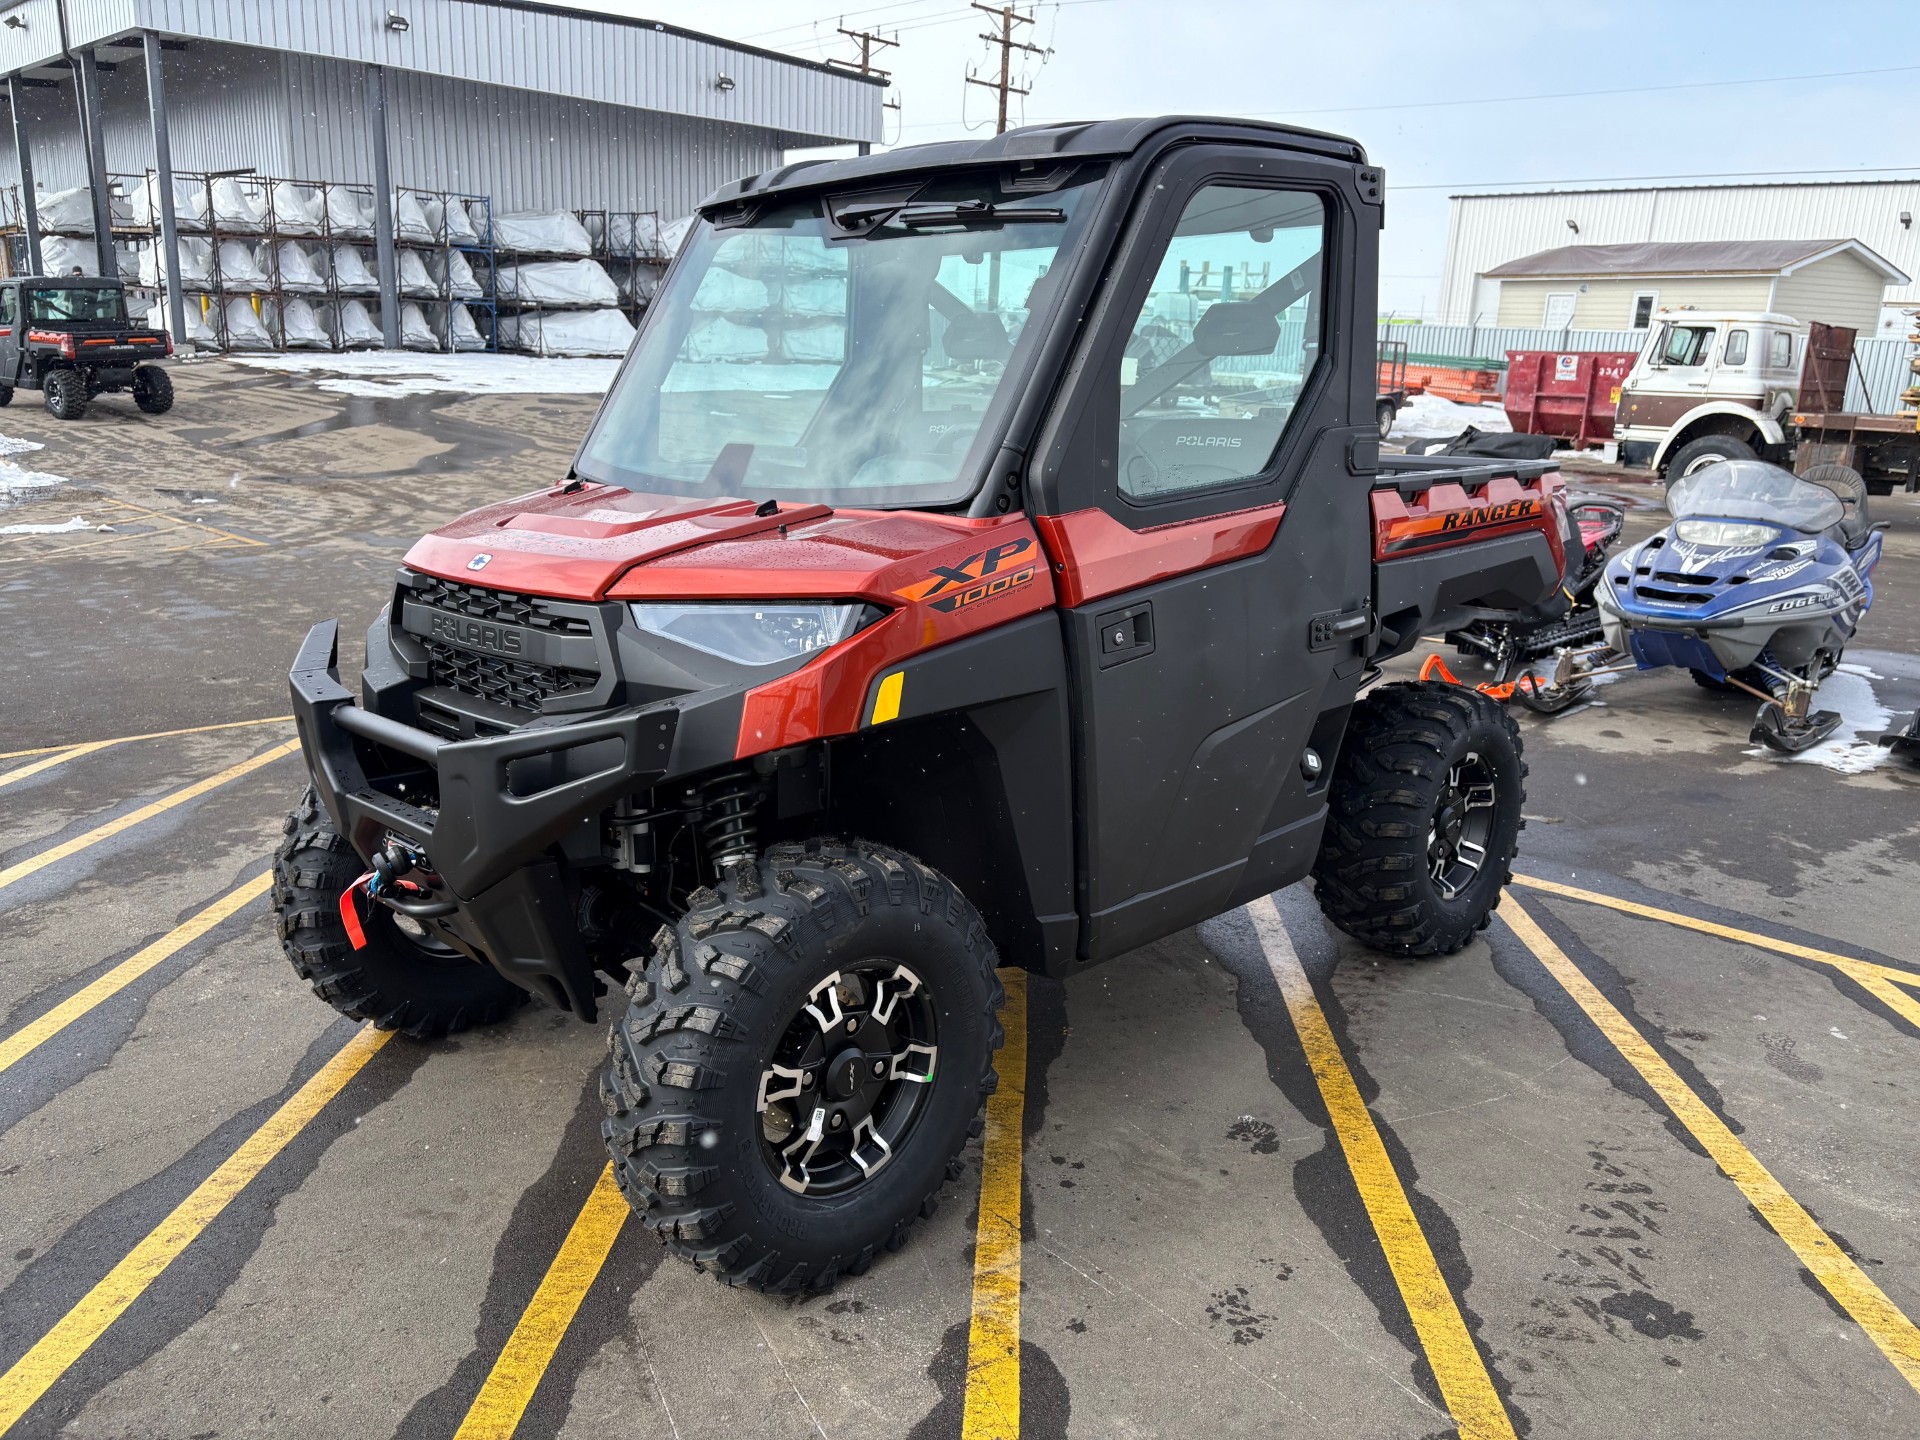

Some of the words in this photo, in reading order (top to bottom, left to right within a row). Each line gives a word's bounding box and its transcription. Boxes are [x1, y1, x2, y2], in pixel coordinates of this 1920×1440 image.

[1176, 436, 1242, 448] POLARIS
[1441, 500, 1533, 531] RANGER
[921, 537, 1033, 598] XP
[955, 567, 1034, 608] 1000
[1769, 595, 1817, 614] EDGE
[431, 613, 522, 656] POLARIS
